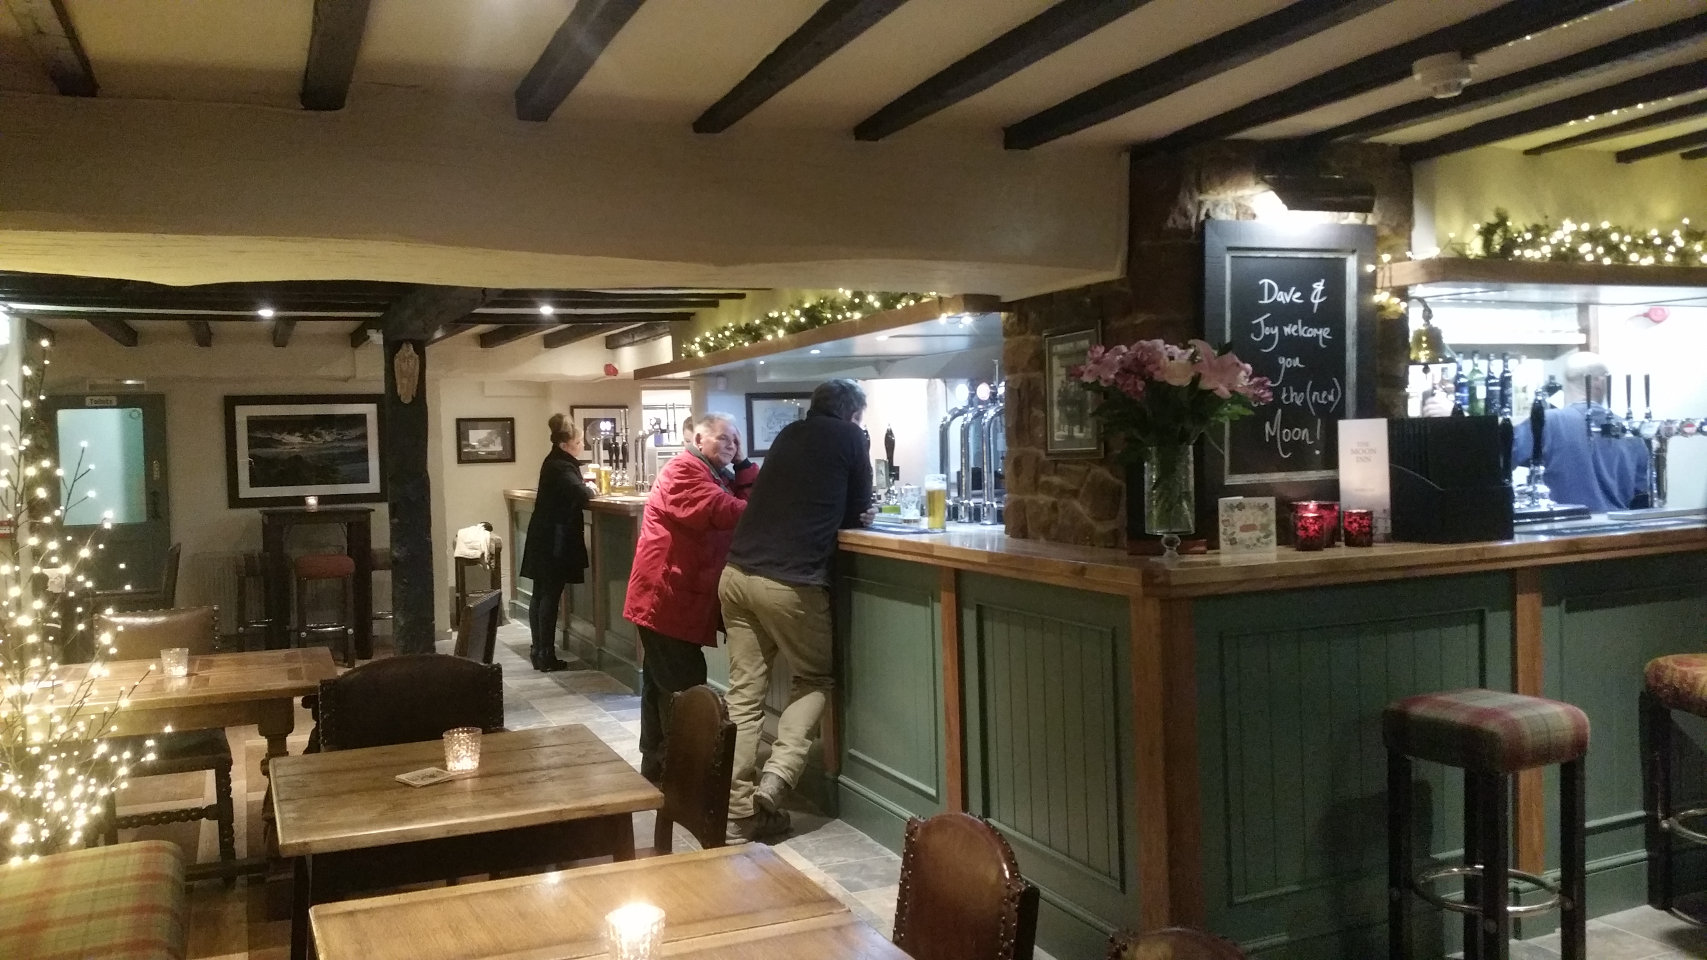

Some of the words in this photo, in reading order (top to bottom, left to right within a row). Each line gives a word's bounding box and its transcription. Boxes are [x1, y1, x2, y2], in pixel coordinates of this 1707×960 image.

[1258, 278, 1304, 304] Dave
[1310, 278, 1328, 313] &
[1251, 313, 1279, 353] Joy
[1283, 319, 1333, 348] welcome
[1270, 355, 1306, 387] you
[1281, 386, 1304, 407] the
[1264, 408, 1322, 459] Moon!
